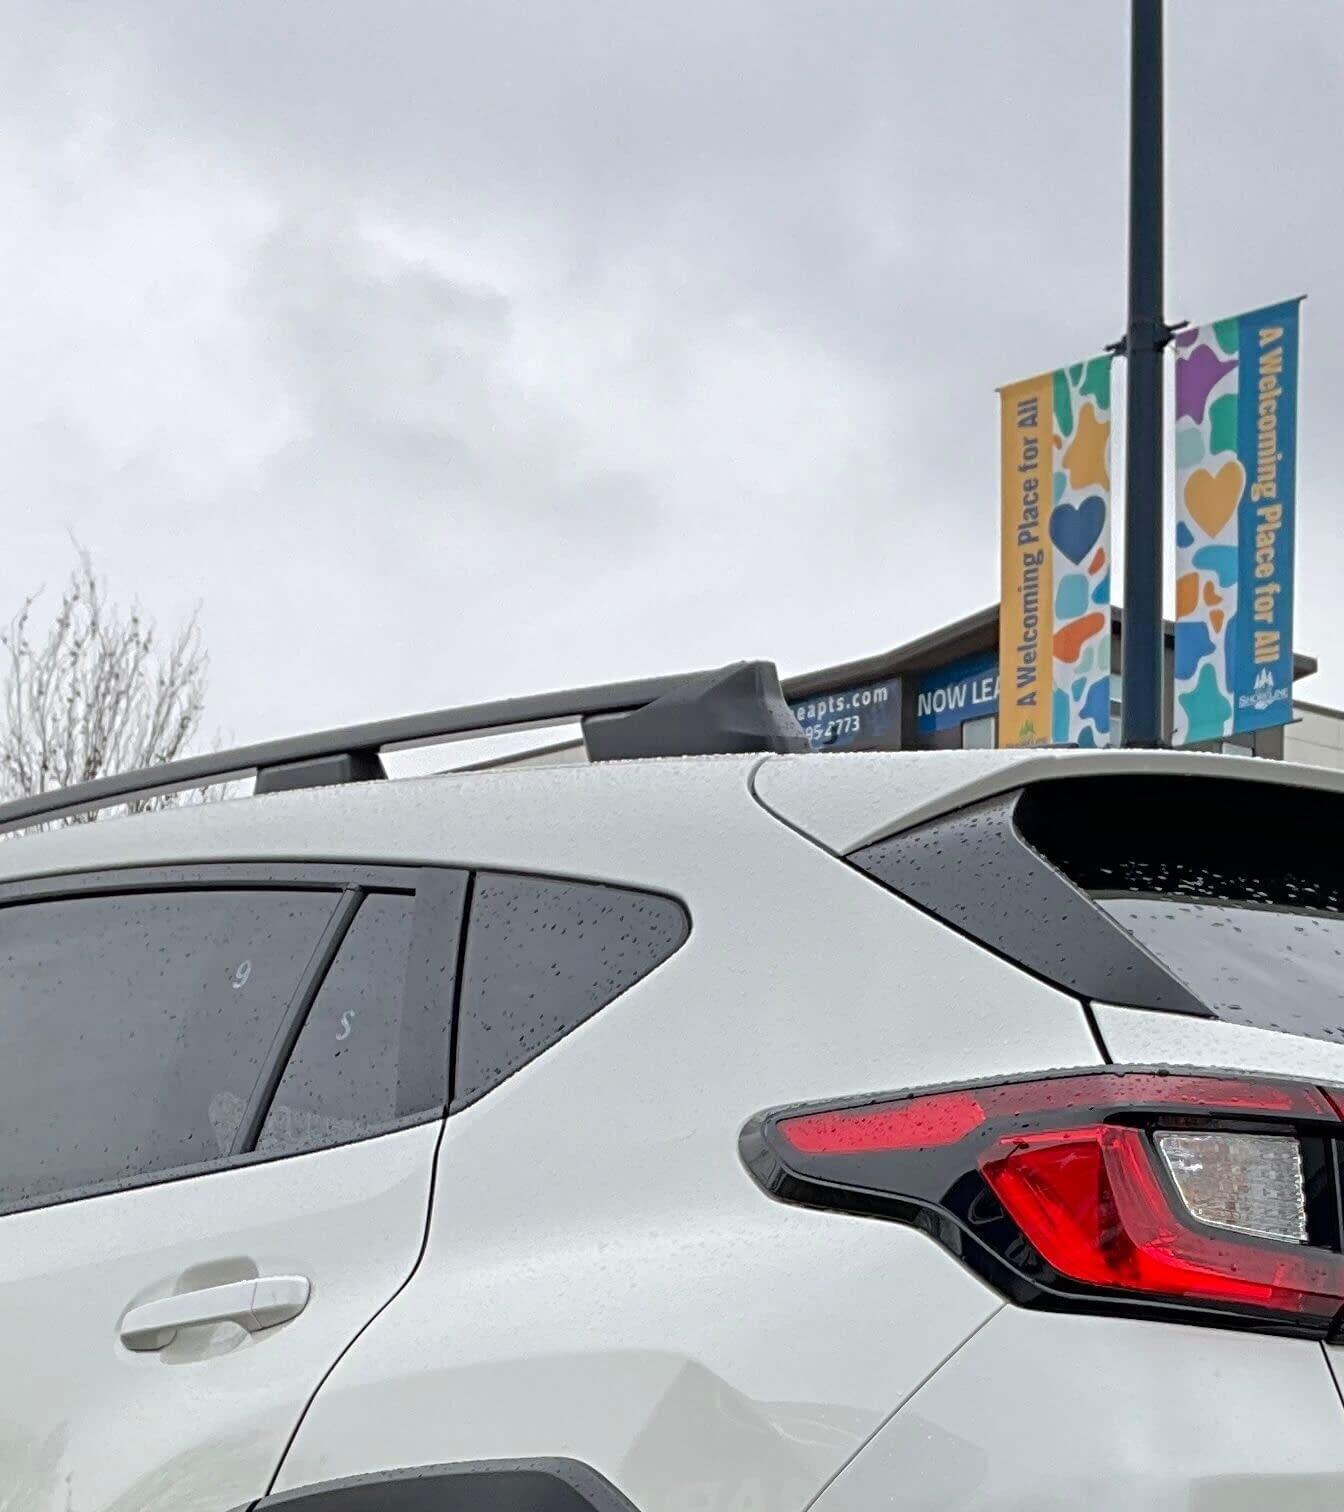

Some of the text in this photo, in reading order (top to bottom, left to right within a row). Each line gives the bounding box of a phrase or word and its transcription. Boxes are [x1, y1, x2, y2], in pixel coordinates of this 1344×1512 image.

[1017, 398, 1044, 706] A Welcoming Place for All
[1251, 328, 1284, 664] A Welcoming Place for All
[792, 686, 888, 721] eapts.com
[917, 684, 967, 717] NOW
